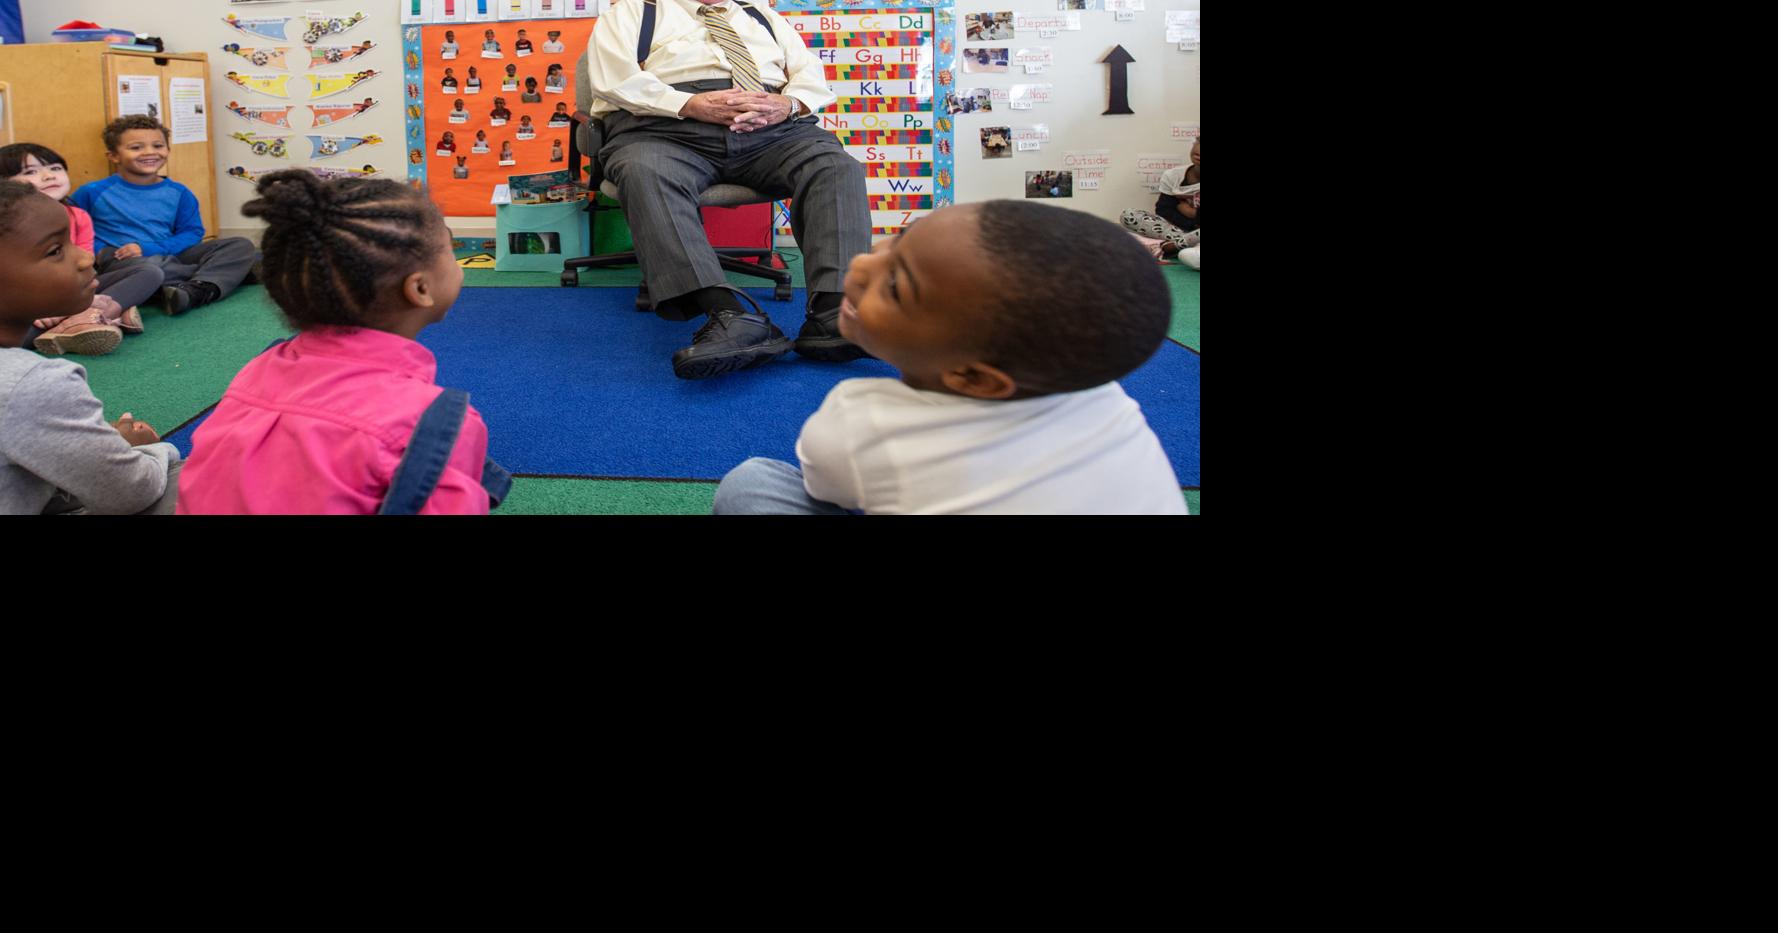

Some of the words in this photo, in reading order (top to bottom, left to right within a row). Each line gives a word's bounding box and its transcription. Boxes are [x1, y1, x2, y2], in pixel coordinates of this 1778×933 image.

[819, 16, 842, 31] Bb
[858, 16, 881, 30] Cc
[899, 15, 923, 29] Dd
[819, 50, 837, 64] Ff
[855, 49, 883, 65] Gg
[860, 81, 883, 95] Kk
[1029, 88, 1048, 103] Nap
[823, 115, 848, 128] Nn
[861, 114, 889, 128] Oo
[903, 114, 923, 131] Pp
[866, 147, 886, 160] Ss
[906, 147, 923, 161] Tt
[1064, 153, 1109, 166] Outside
[1076, 168, 1105, 179] Time
[888, 179, 923, 192] Ww
